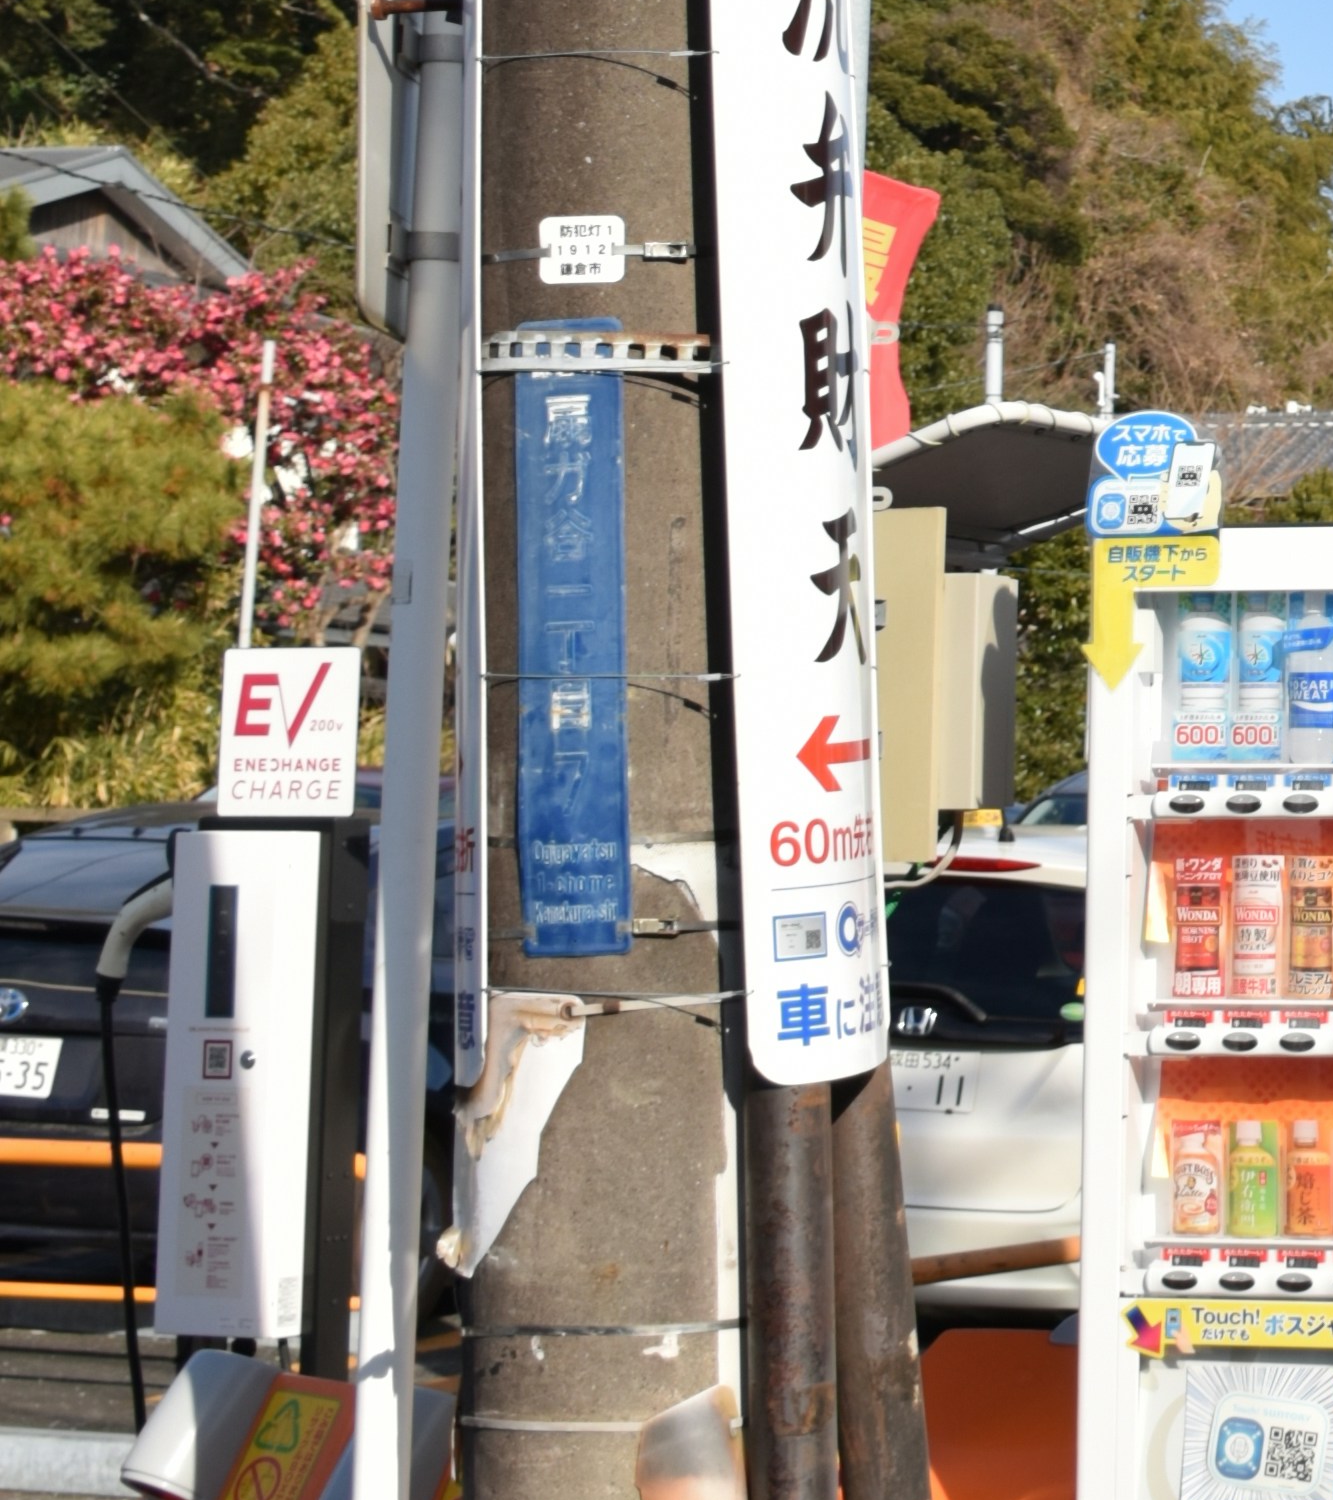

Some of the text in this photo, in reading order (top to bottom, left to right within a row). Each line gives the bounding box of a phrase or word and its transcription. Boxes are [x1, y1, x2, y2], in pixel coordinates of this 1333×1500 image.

[560, 225, 601, 238] 防犯灯
[1112, 424, 1187, 442] スマホで
[1116, 444, 1169, 467] 応募
[1107, 544, 1207, 564] 自販機下から
[1122, 564, 1186, 582] スタート
[234, 662, 332, 749] EV
[1176, 724, 1219, 746] 600
[1232, 724, 1274, 746] 600
[231, 780, 341, 800] CHARGE
[1191, 1307, 1260, 1326] Touch!
[1201, 1327, 1250, 1341] だけでも
